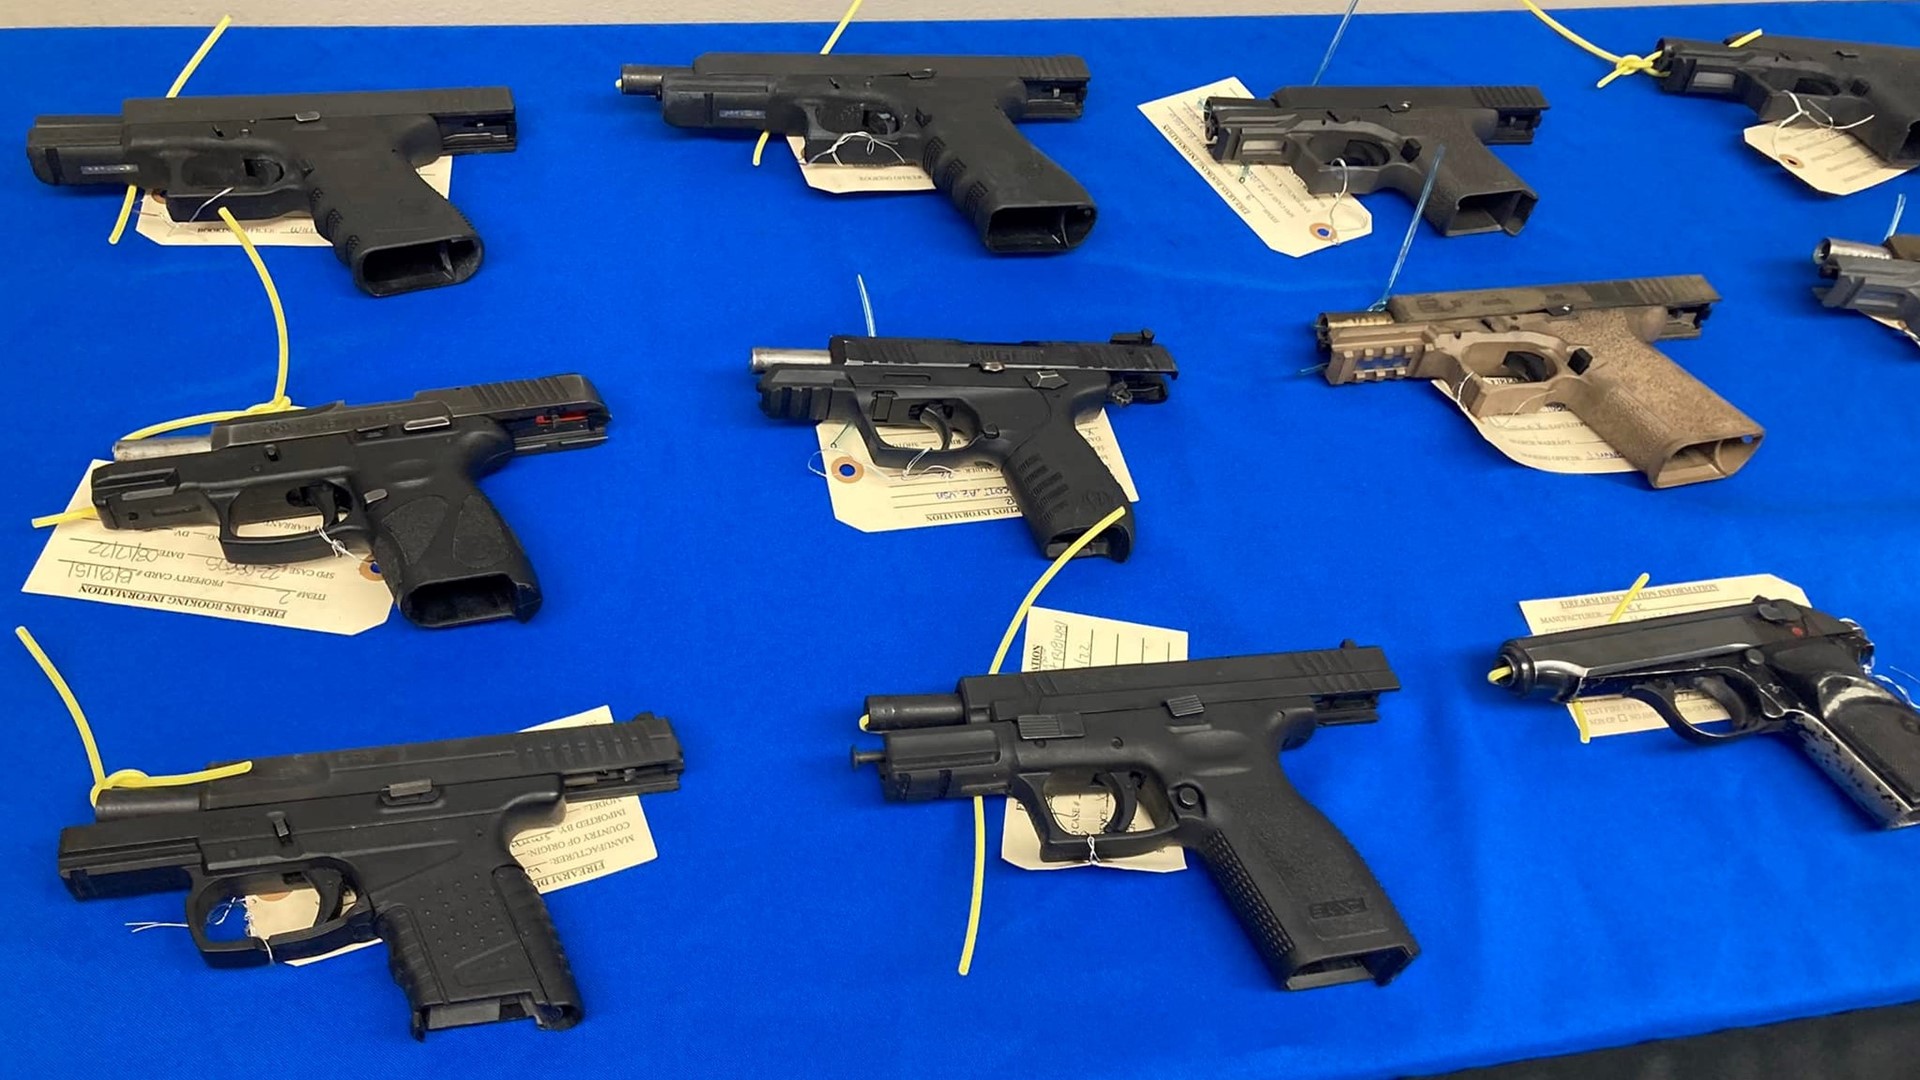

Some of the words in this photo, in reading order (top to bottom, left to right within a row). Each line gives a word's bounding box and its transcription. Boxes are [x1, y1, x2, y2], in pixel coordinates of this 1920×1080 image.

[143, 569, 173, 580] CARD
[288, 567, 315, 577] CASE
[315, 571, 336, 580] SPD
[174, 575, 225, 588] PROPERTY
[78, 584, 165, 603] INFORMATION
[168, 596, 221, 611] BOOKING
[224, 602, 288, 619] FIREARMS
[575, 808, 627, 829] IMPORTED
[583, 821, 631, 843] COUNTRY
[527, 841, 566, 857] ORIGIN:
[549, 834, 635, 865] MANUFACTURER:
[567, 836, 581, 847] OF
[552, 860, 606, 882] FIREARM
